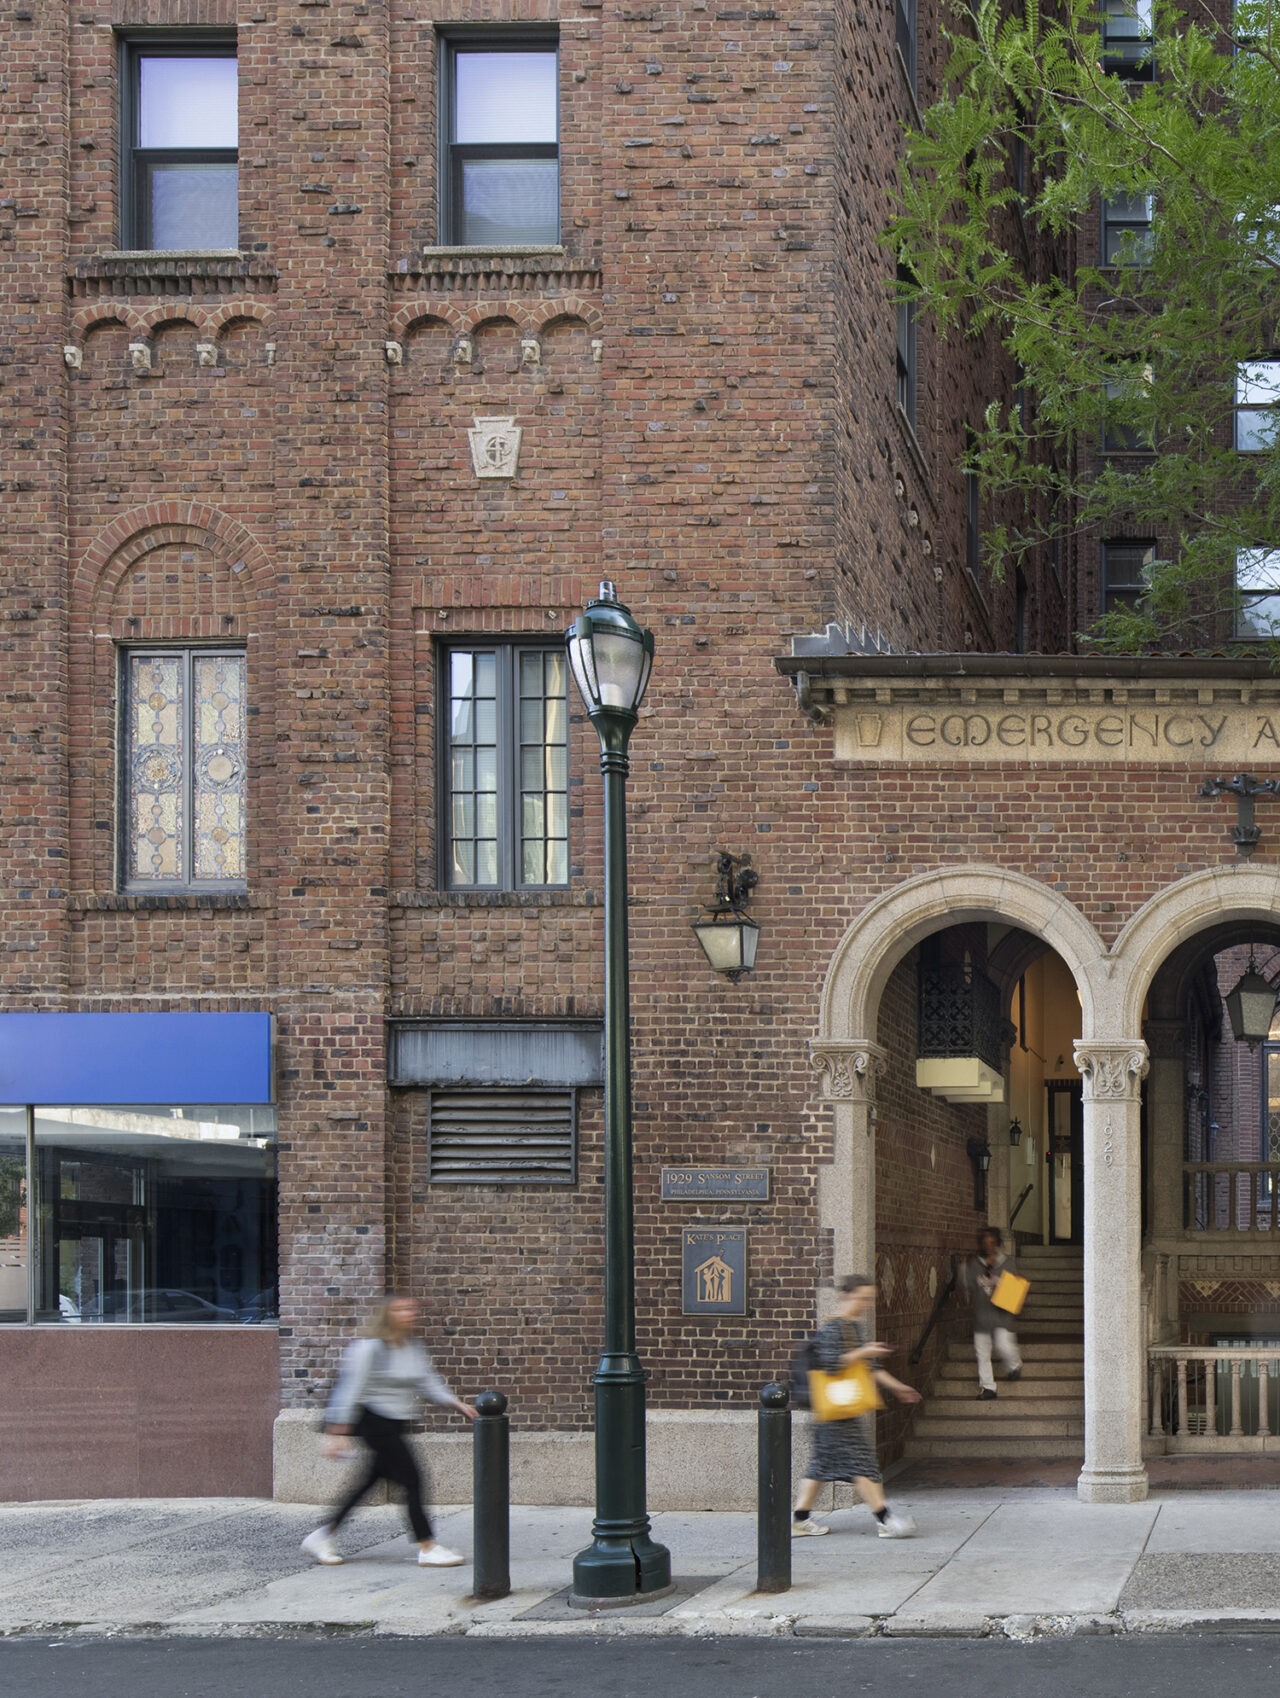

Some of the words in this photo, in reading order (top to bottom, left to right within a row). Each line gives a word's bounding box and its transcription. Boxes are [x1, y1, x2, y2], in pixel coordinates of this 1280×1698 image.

[906, 714, 1228, 747] EMERGENCY
[1103, 1113, 1113, 1169] 1929
[666, 1173, 693, 1185] 1929
[735, 1173, 764, 1185] STREET
